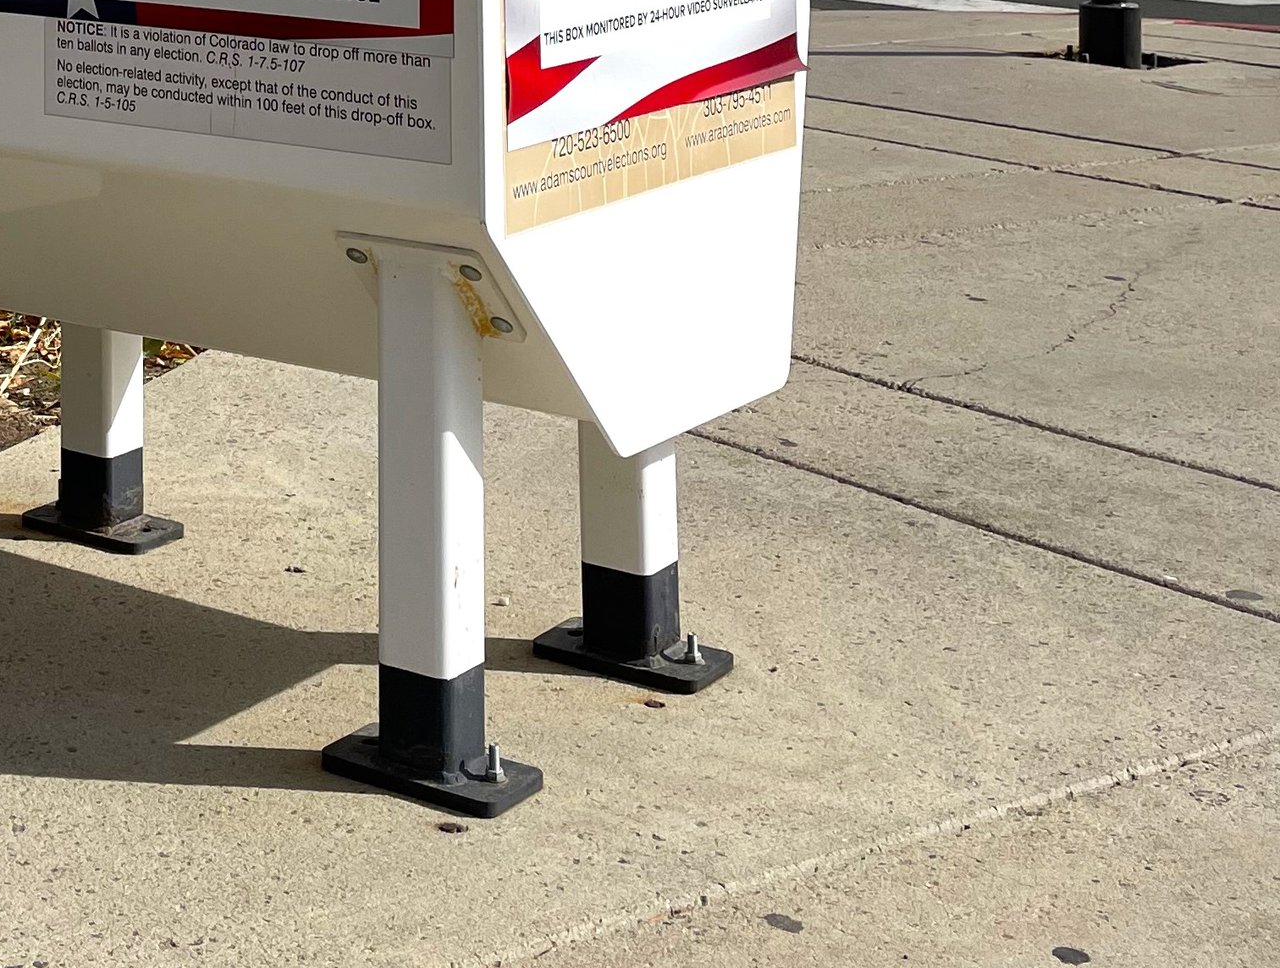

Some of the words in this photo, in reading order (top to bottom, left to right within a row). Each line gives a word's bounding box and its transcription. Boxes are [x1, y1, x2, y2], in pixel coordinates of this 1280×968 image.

[57, 20, 106, 36] NOTICE:
[110, 26, 118, 37] It
[120, 27, 129, 39] is
[132, 30, 140, 40] a
[143, 30, 191, 44] violation
[195, 34, 206, 46] of
[209, 34, 265, 51] Colorado
[269, 39, 290, 54] law
[293, 43, 305, 56] to
[309, 44, 339, 61] drop
[343, 47, 359, 61] off
[363, 51, 397, 64] more
[402, 52, 431, 68] than
[544, 30, 564, 46] THIS
[565, 26, 584, 42] BOX
[586, 15, 636, 37] MONITORED
[638, 12, 648, 26] BY
[650, 4, 686, 24] 24-HOUR
[687, 0, 711, 16] VIDEO
[57, 37, 73, 50] ten
[77, 39, 113, 54] ballots
[117, 42, 127, 55] in
[130, 46, 150, 60] any
[154, 47, 202, 63] election.
[206, 51, 242, 67] C.R.S.
[247, 56, 305, 72] 1-7.5-107
[57, 58, 72, 72] No
[76, 61, 162, 82] election-related
[165, 71, 207, 89] activity,
[212, 76, 251, 92] except
[255, 80, 278, 94] that
[281, 83, 293, 96] of
[297, 84, 317, 99] the
[321, 88, 374, 105] conduct
[378, 93, 390, 107] of
[394, 95, 417, 110] this
[57, 91, 90, 107] C.R.S.
[95, 96, 136, 112] 1-5-105
[57, 77, 102, 93] election,
[106, 83, 130, 97] may
[133, 83, 148, 97] be
[151, 86, 213, 104] conducted
[217, 94, 252, 109] within
[256, 97, 278, 112] 100
[282, 100, 305, 115] feet
[309, 103, 321, 116] of
[324, 105, 347, 120] this
[351, 108, 403, 126] drop-off
[407, 114, 436, 130] box.
[703, 86, 772, 118] 303-795-4511
[551, 118, 631, 159] 720-523-6500
[685, 107, 791, 149] www.arapahoevotes.com
[512, 141, 667, 200] www.adamscountyelections.org
